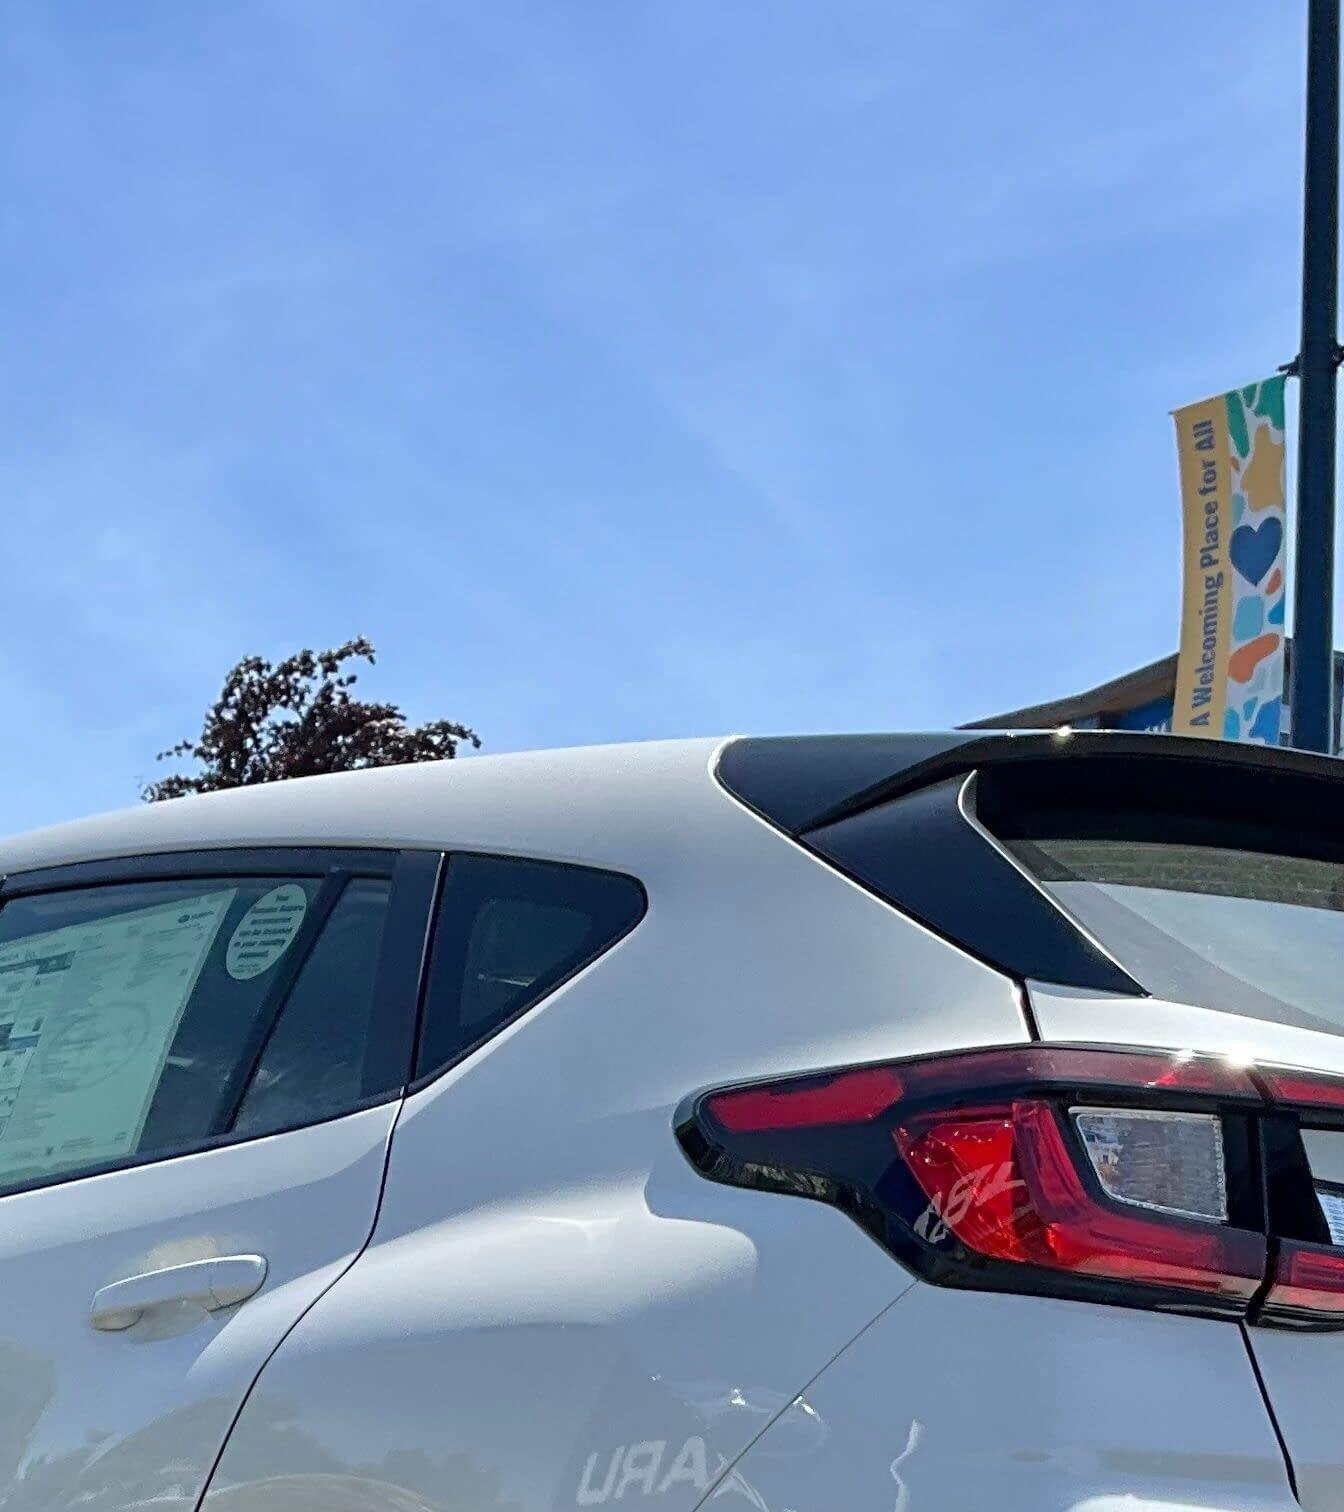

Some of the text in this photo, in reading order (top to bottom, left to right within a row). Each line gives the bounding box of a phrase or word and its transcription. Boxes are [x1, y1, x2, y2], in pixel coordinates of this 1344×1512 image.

[1189, 419, 1224, 727] A Welcoming Place for All
